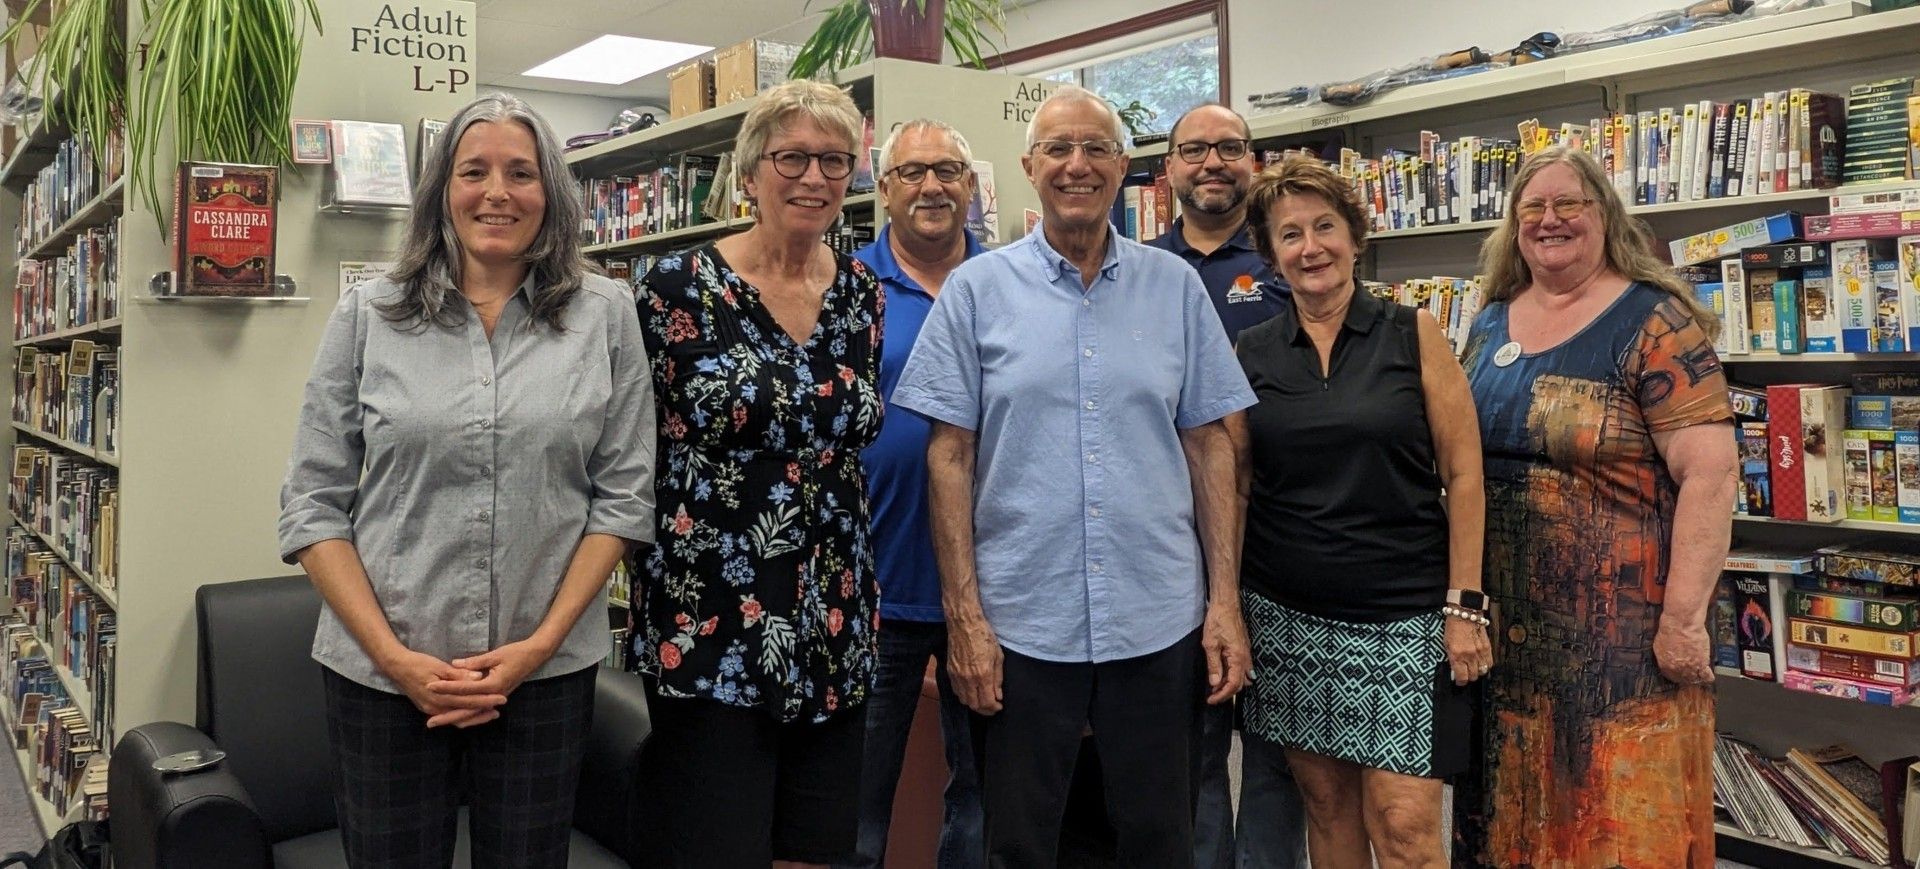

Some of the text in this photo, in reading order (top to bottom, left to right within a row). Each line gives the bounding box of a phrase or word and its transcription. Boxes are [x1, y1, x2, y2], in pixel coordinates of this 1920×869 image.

[374, 4, 467, 37] Adult
[351, 27, 467, 63] Fiction
[413, 65, 470, 94] L-P
[1312, 112, 1350, 127] Biography
[194, 210, 268, 227] CASSANDRA
[211, 225, 251, 239] CLARE
[1733, 222, 1755, 239] 500
